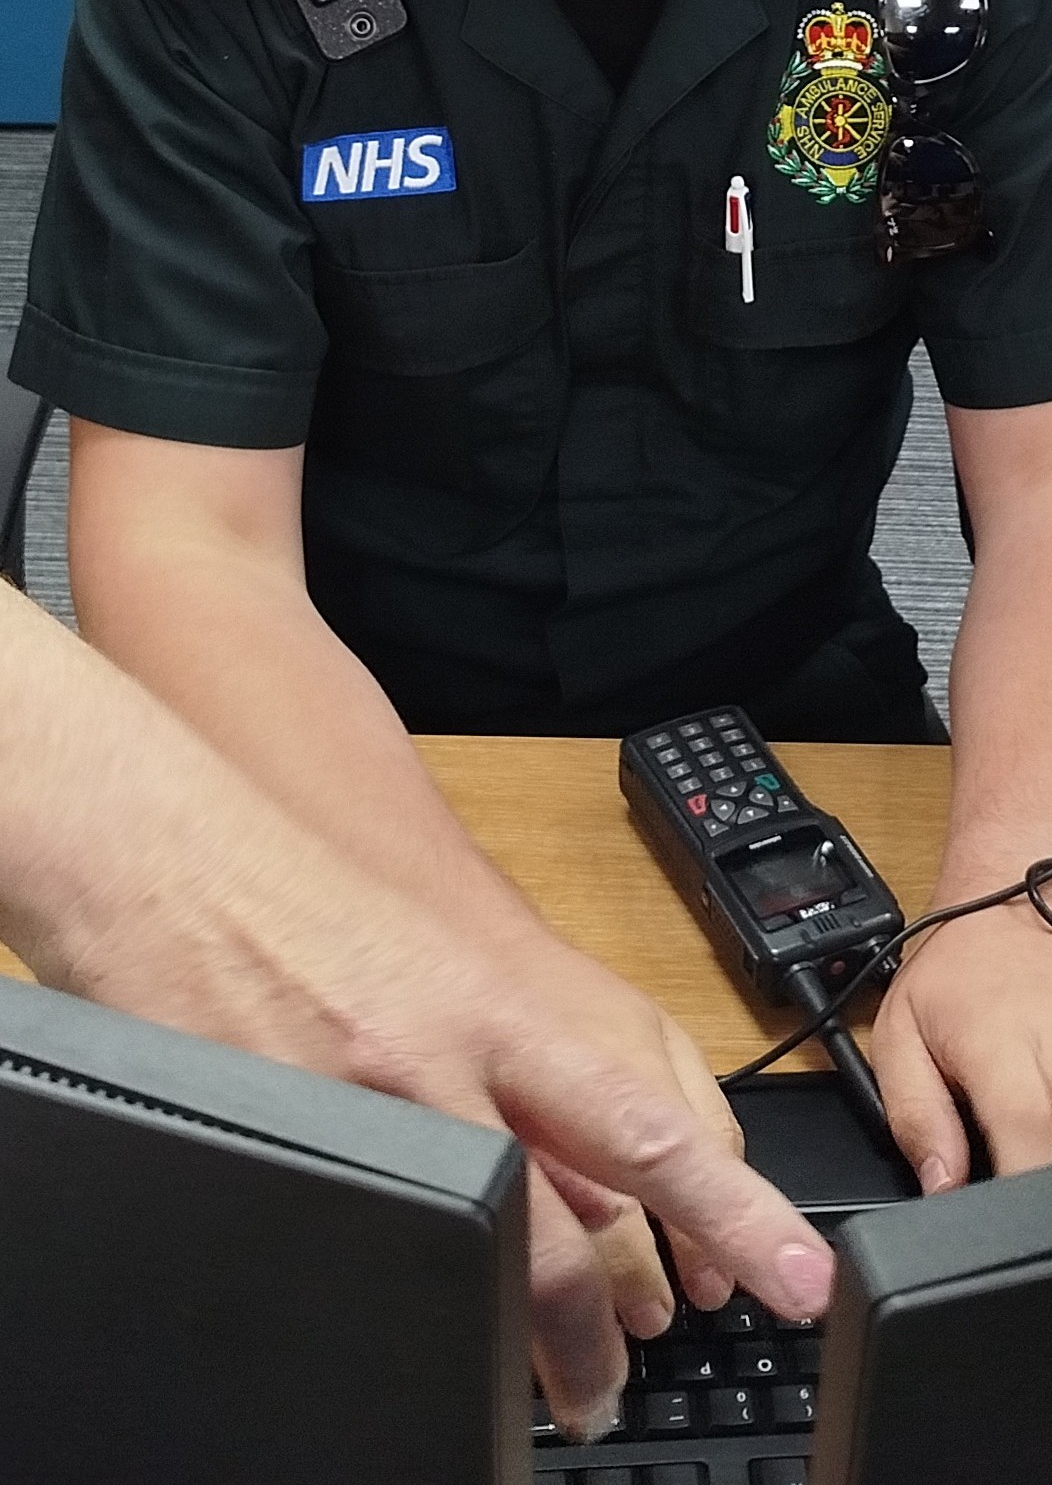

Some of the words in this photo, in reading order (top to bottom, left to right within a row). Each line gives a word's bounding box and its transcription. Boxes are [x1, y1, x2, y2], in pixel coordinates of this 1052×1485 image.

[797, 79, 877, 119] AMBULANCE
[796, 125, 825, 160] NHS
[853, 102, 886, 160] SERVICE
[313, 134, 443, 196] NHS
[739, 1314, 751, 1326] L
[699, 1361, 712, 1375] P
[757, 1358, 773, 1372] O
